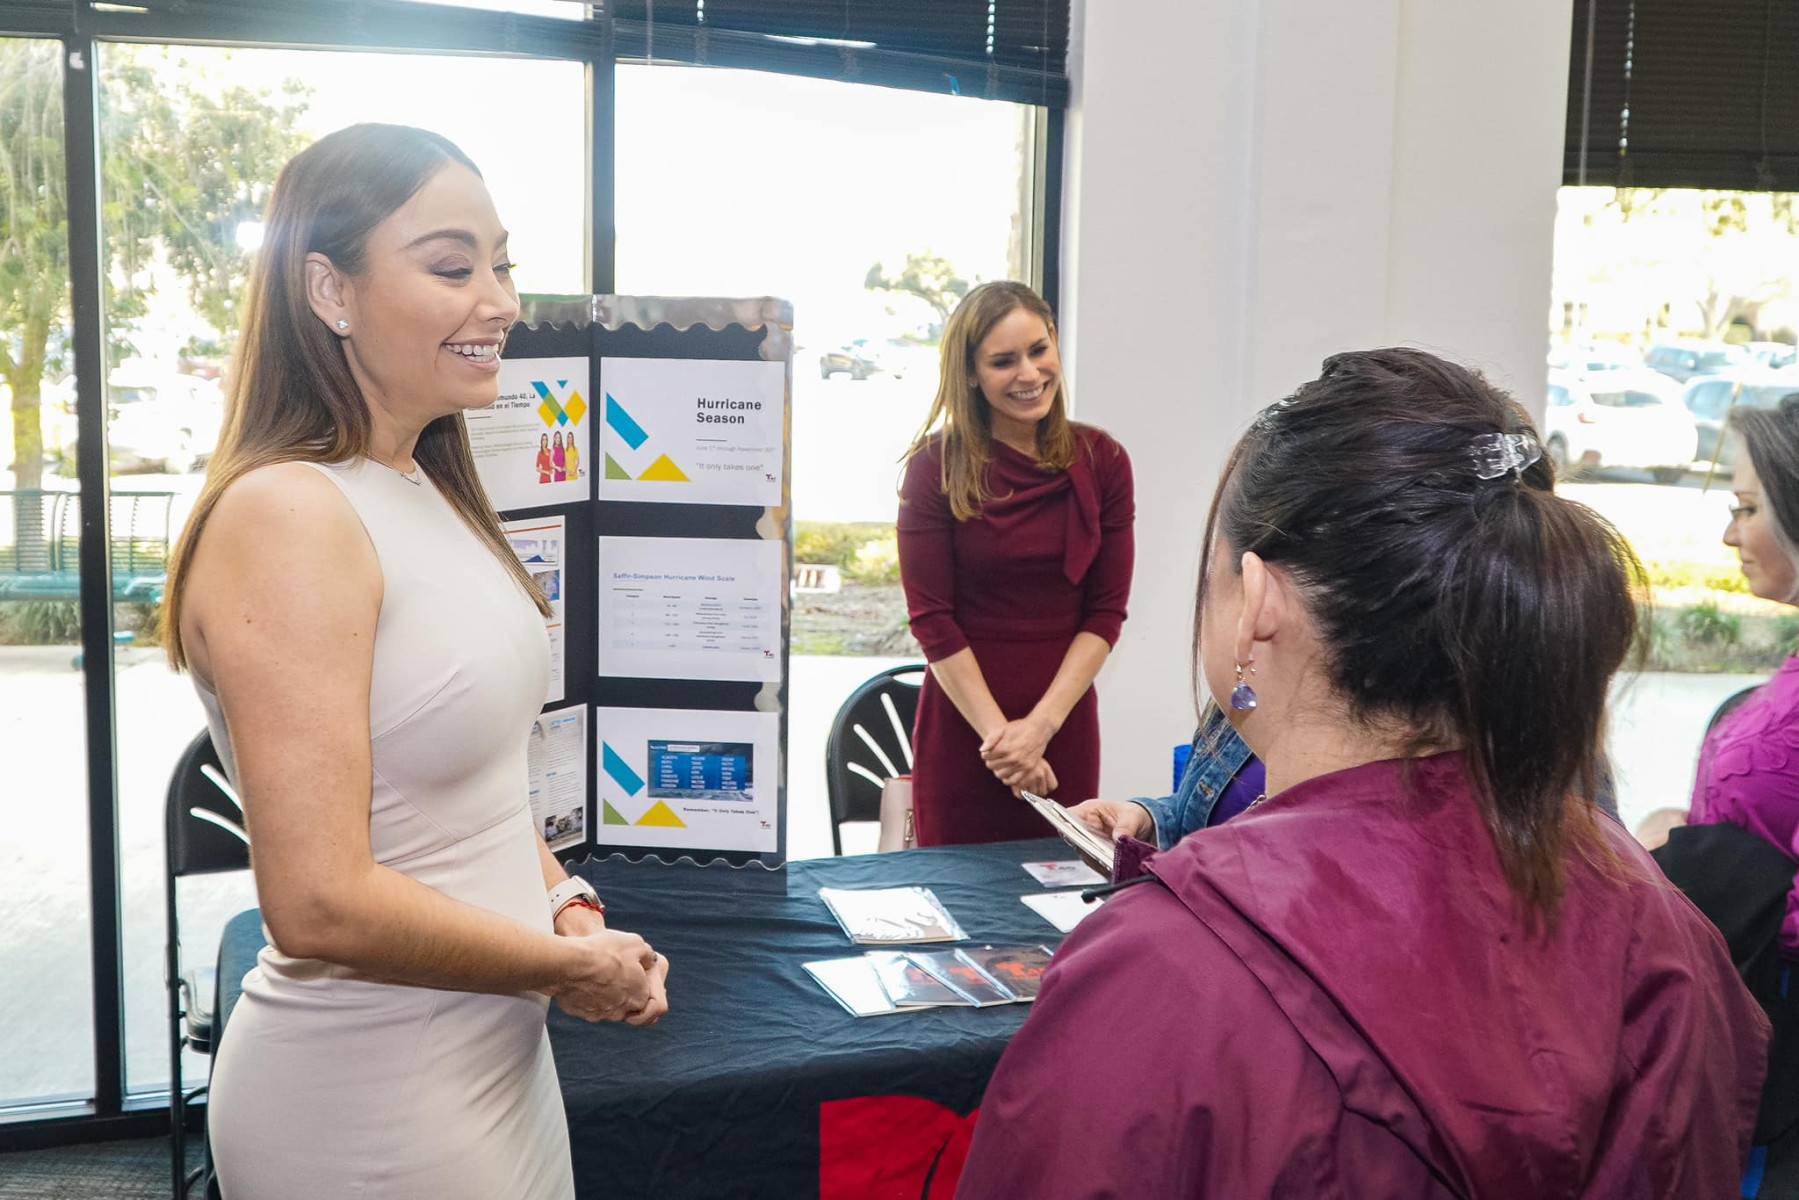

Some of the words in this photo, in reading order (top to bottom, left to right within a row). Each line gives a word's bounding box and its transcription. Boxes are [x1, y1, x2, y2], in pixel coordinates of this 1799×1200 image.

[511, 400, 530, 408] Tiempo
[697, 397, 762, 410] Hurricane
[696, 411, 745, 424] Season
[706, 463, 722, 471] only
